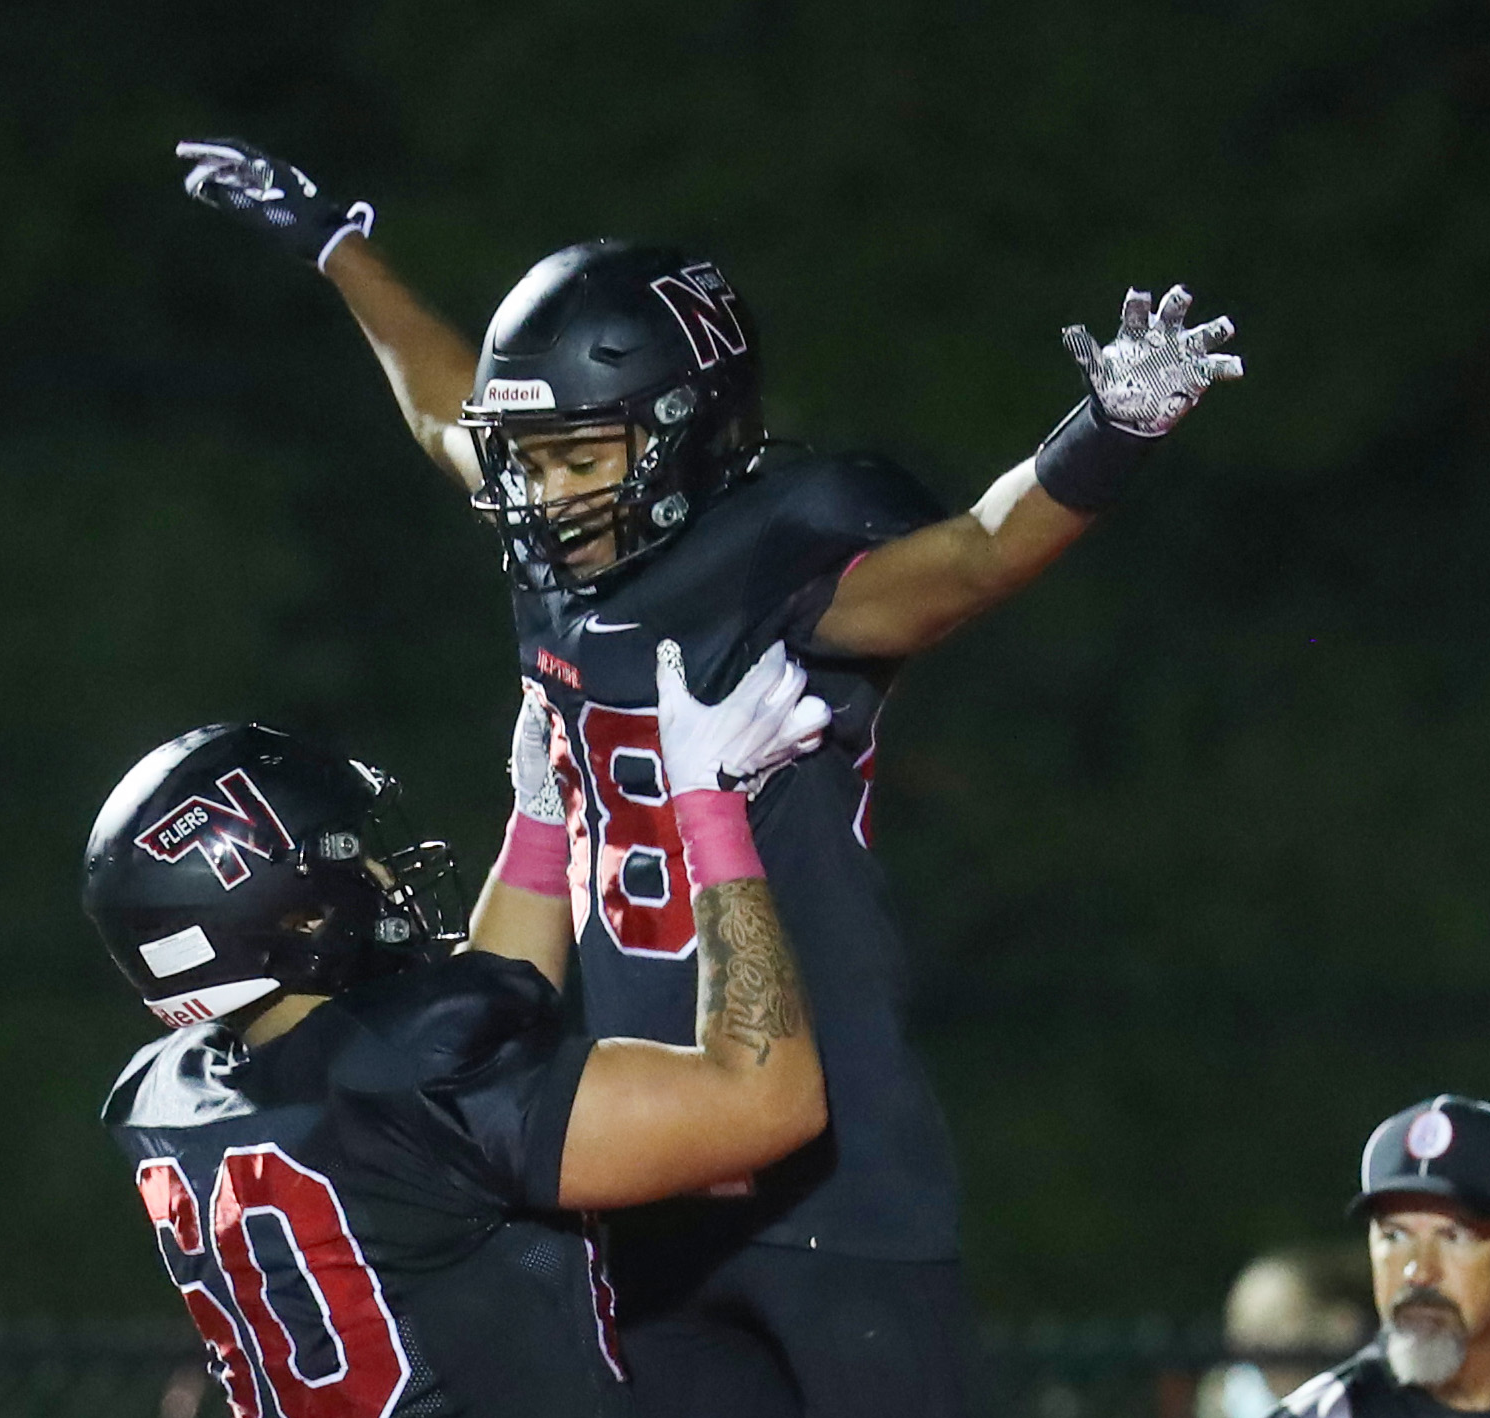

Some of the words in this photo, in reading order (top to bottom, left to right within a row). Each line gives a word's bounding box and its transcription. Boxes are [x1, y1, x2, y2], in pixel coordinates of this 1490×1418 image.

[649, 261, 747, 370] N
[488, 386, 541, 401] Riddell
[158, 806, 209, 849] FLIERS
